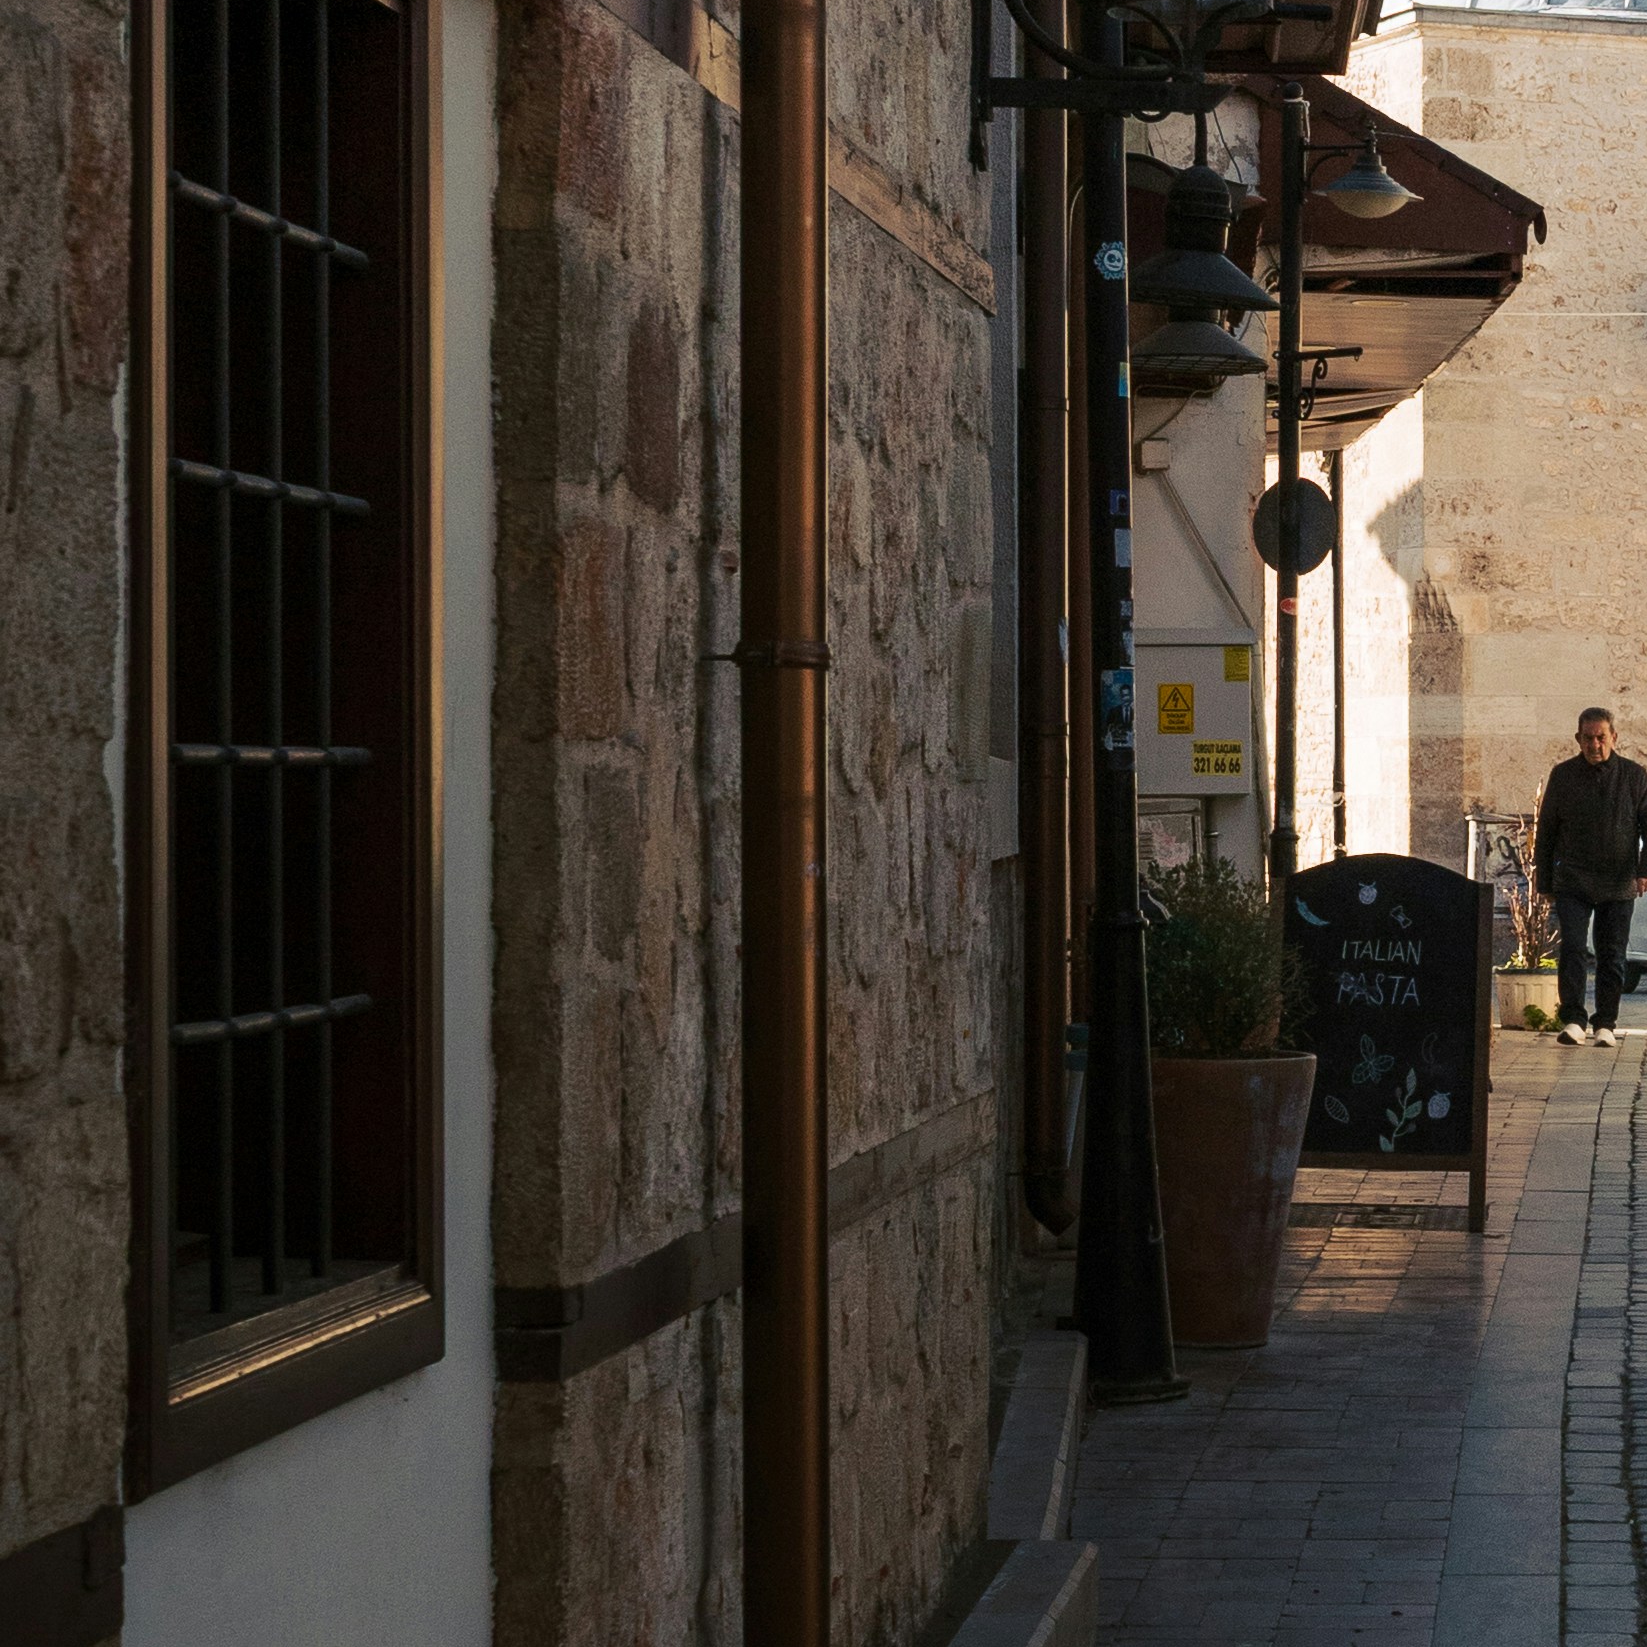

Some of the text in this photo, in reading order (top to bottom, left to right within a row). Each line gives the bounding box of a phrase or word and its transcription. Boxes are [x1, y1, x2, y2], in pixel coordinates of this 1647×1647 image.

[1193, 757, 1241, 773] 321 66 66
[1341, 939, 1422, 966] ITALIAN
[1337, 971, 1421, 1007] PASTA
